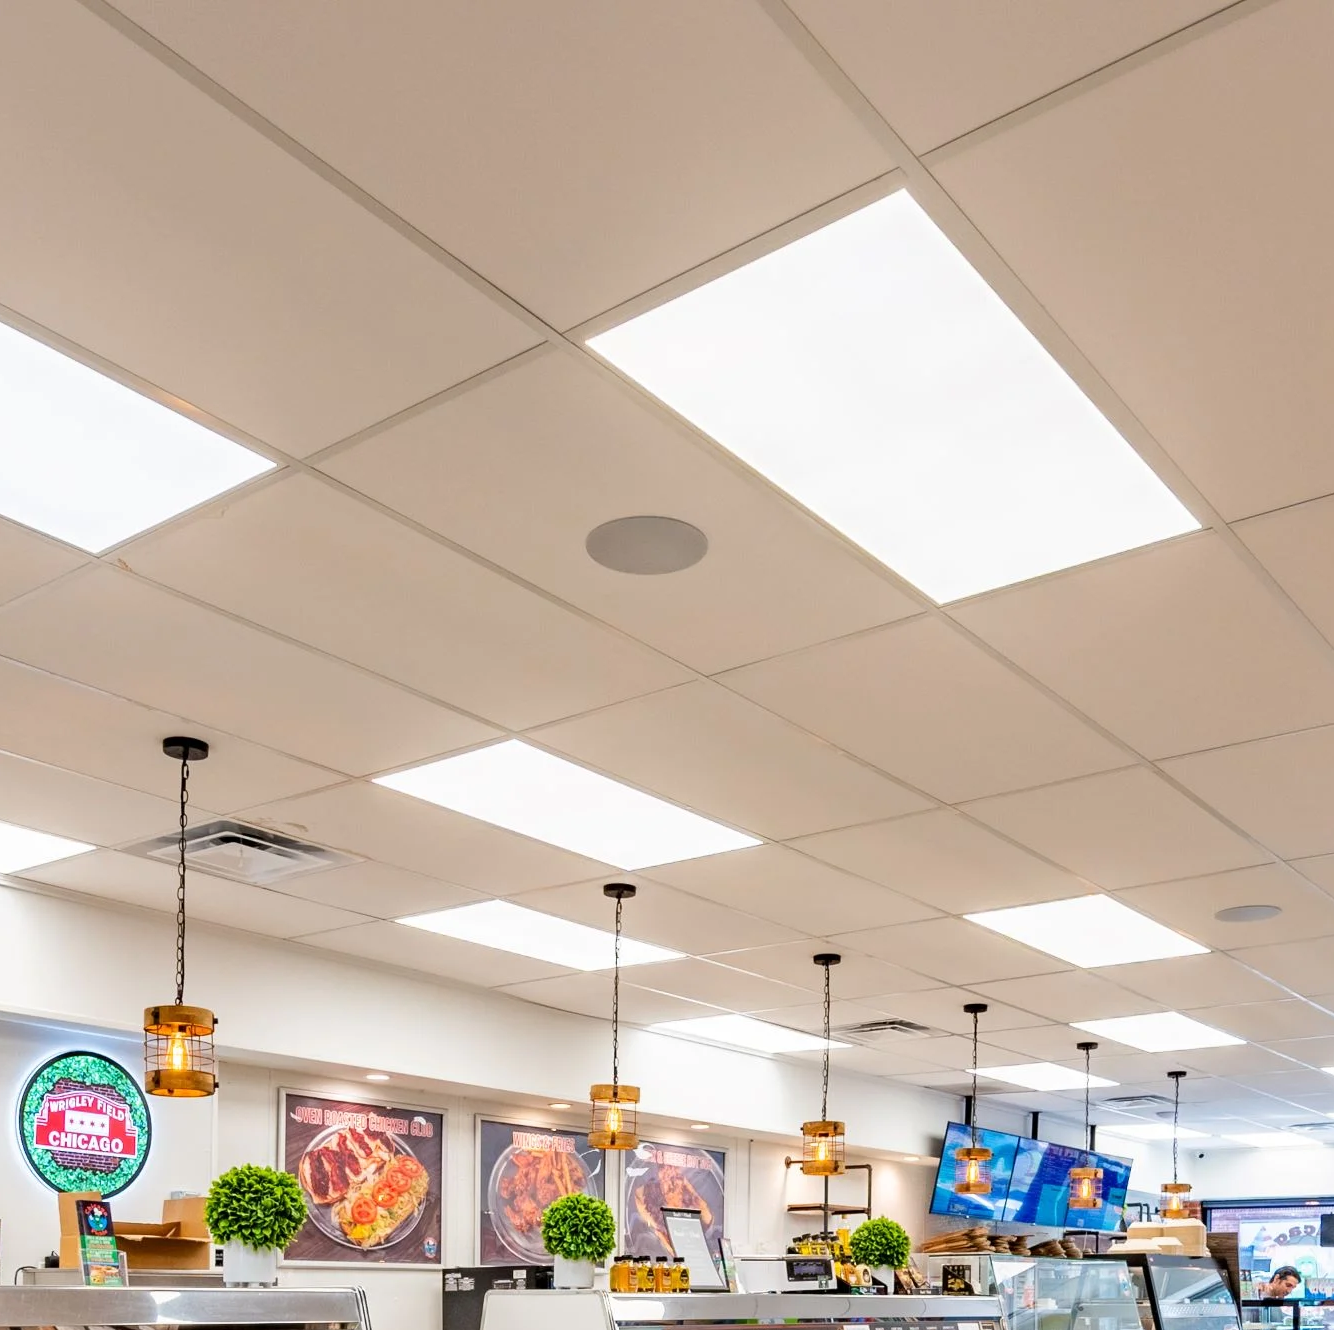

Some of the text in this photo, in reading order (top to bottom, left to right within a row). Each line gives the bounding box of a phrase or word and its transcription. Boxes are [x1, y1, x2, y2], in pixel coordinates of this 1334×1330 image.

[49, 1095, 126, 1121] WRIGLEY FIELD
[296, 1106, 323, 1125] OVEN
[324, 1110, 367, 1130] ROASTED
[368, 1115, 409, 1135] CHICKEN
[48, 1131, 124, 1153] CHICAGO
[512, 1131, 541, 1150] WINGS
[552, 1137, 575, 1153] FRIES
